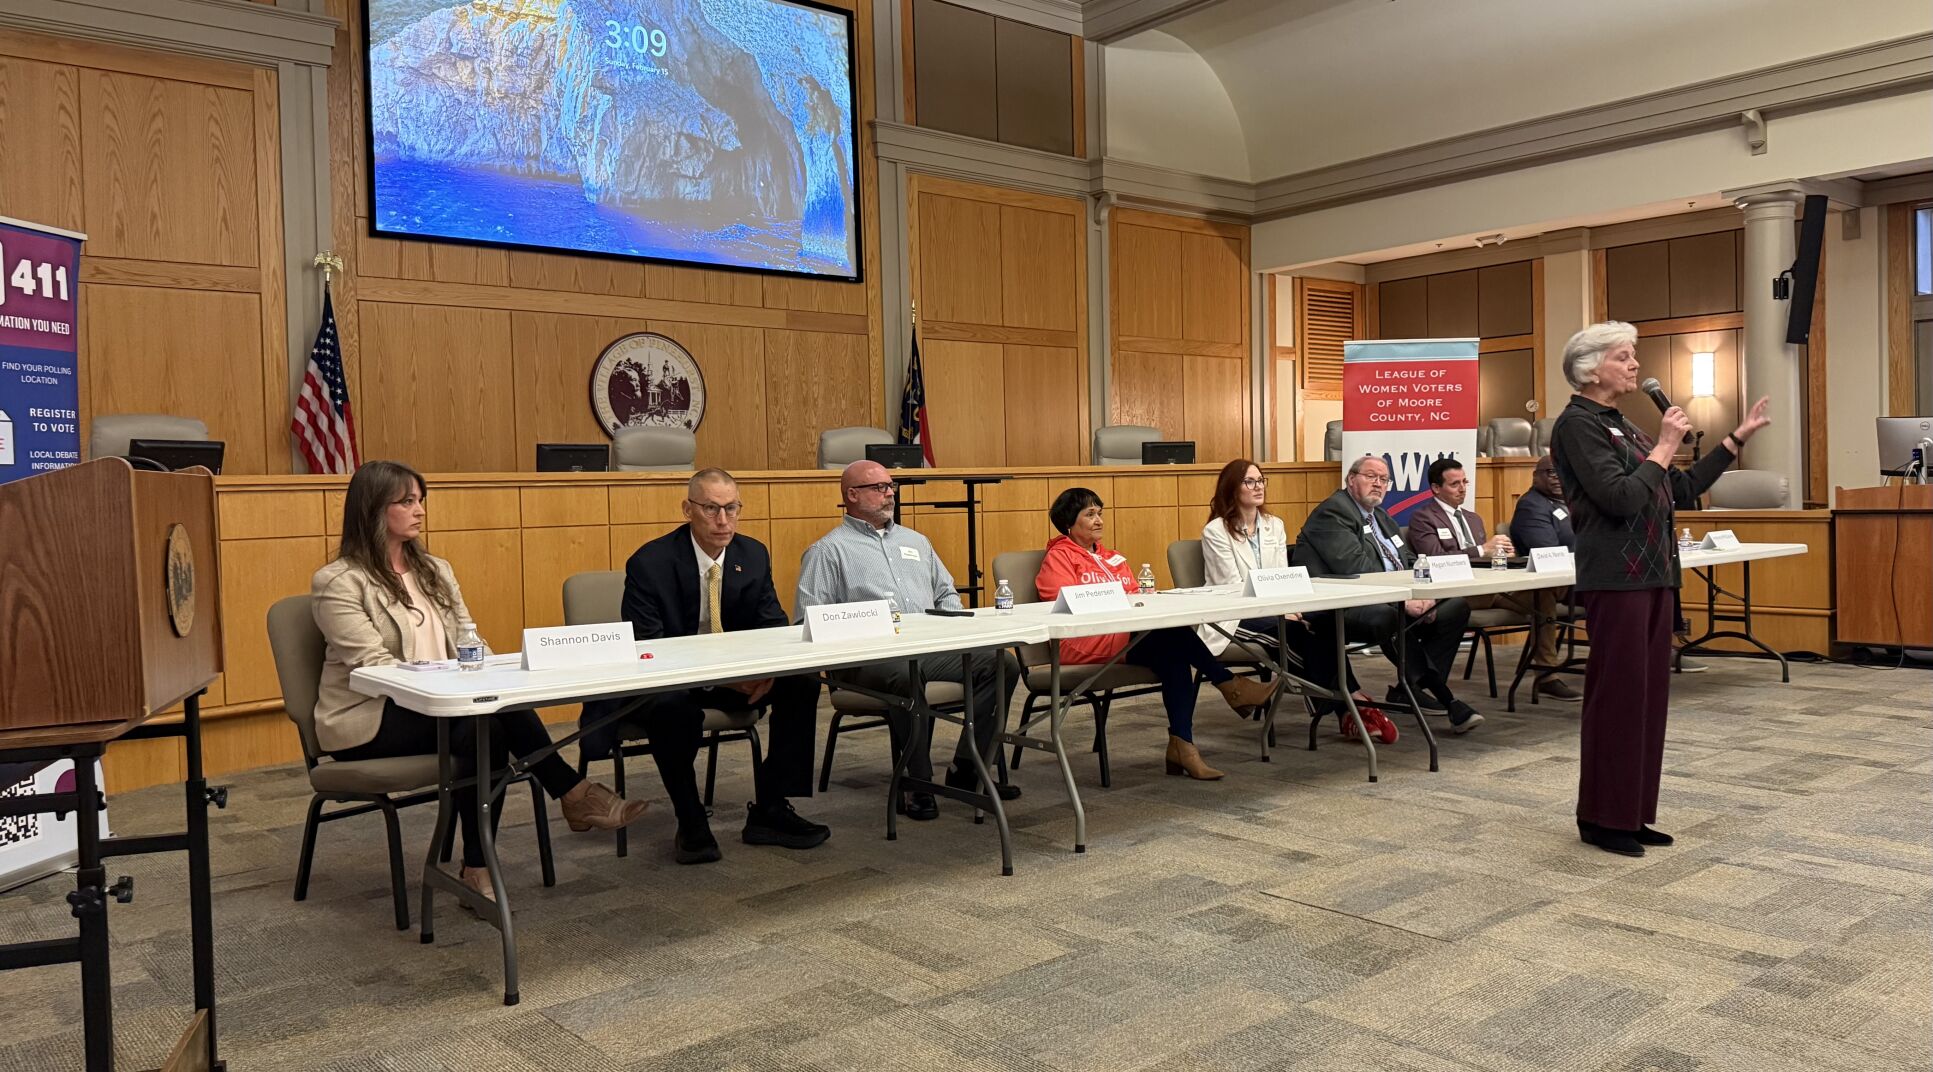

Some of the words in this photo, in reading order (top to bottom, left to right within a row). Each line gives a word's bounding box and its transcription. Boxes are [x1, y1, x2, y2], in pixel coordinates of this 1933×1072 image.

[605, 20, 667, 57] 3:09
[632, 63, 660, 75] February
[11, 259, 69, 301] 411
[31, 319, 50, 332] YOU
[51, 321, 70, 335] NEED
[2, 362, 20, 370] FIND
[22, 364, 43, 372] YOUR
[44, 366, 72, 375] POLLING
[21, 375, 58, 385] LOCATION
[29, 408, 76, 419] REGISTER
[1430, 411, 1450, 420] NC
[33, 422, 48, 432] TO
[50, 423, 75, 433] VOTE
[29, 451, 55, 459] LOCAL
[55, 451, 79, 459] DEBATE
[31, 462, 77, 470] INFORMATI
[1086, 588, 1115, 598] Pedersen
[822, 613, 840, 621] Don
[841, 608, 878, 620] Zawlocki
[540, 636, 589, 647] Shannon
[591, 632, 621, 643] Davis
